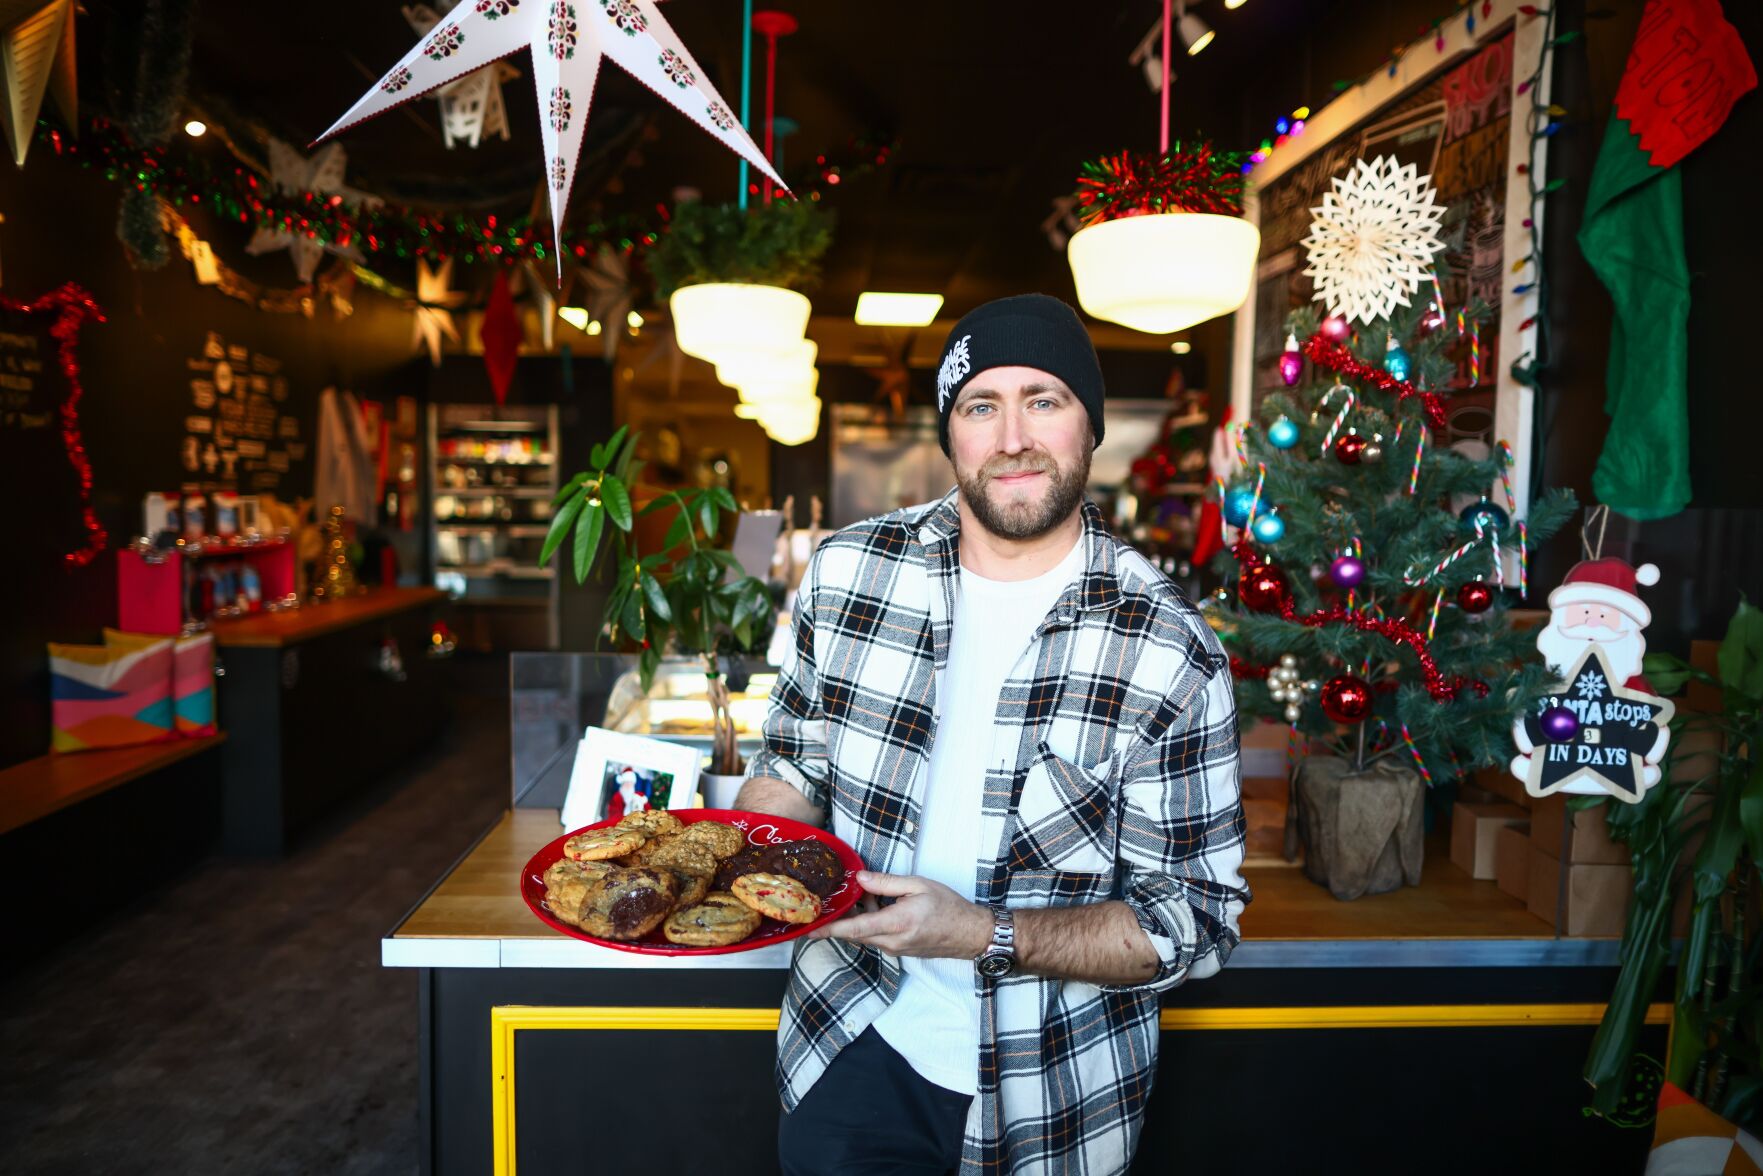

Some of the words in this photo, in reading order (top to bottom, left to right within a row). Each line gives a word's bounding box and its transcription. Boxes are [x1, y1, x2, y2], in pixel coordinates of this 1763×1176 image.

[1604, 700, 1651, 727] stops
[1549, 744, 1570, 762] IN
[1576, 745, 1627, 766] DAYS
